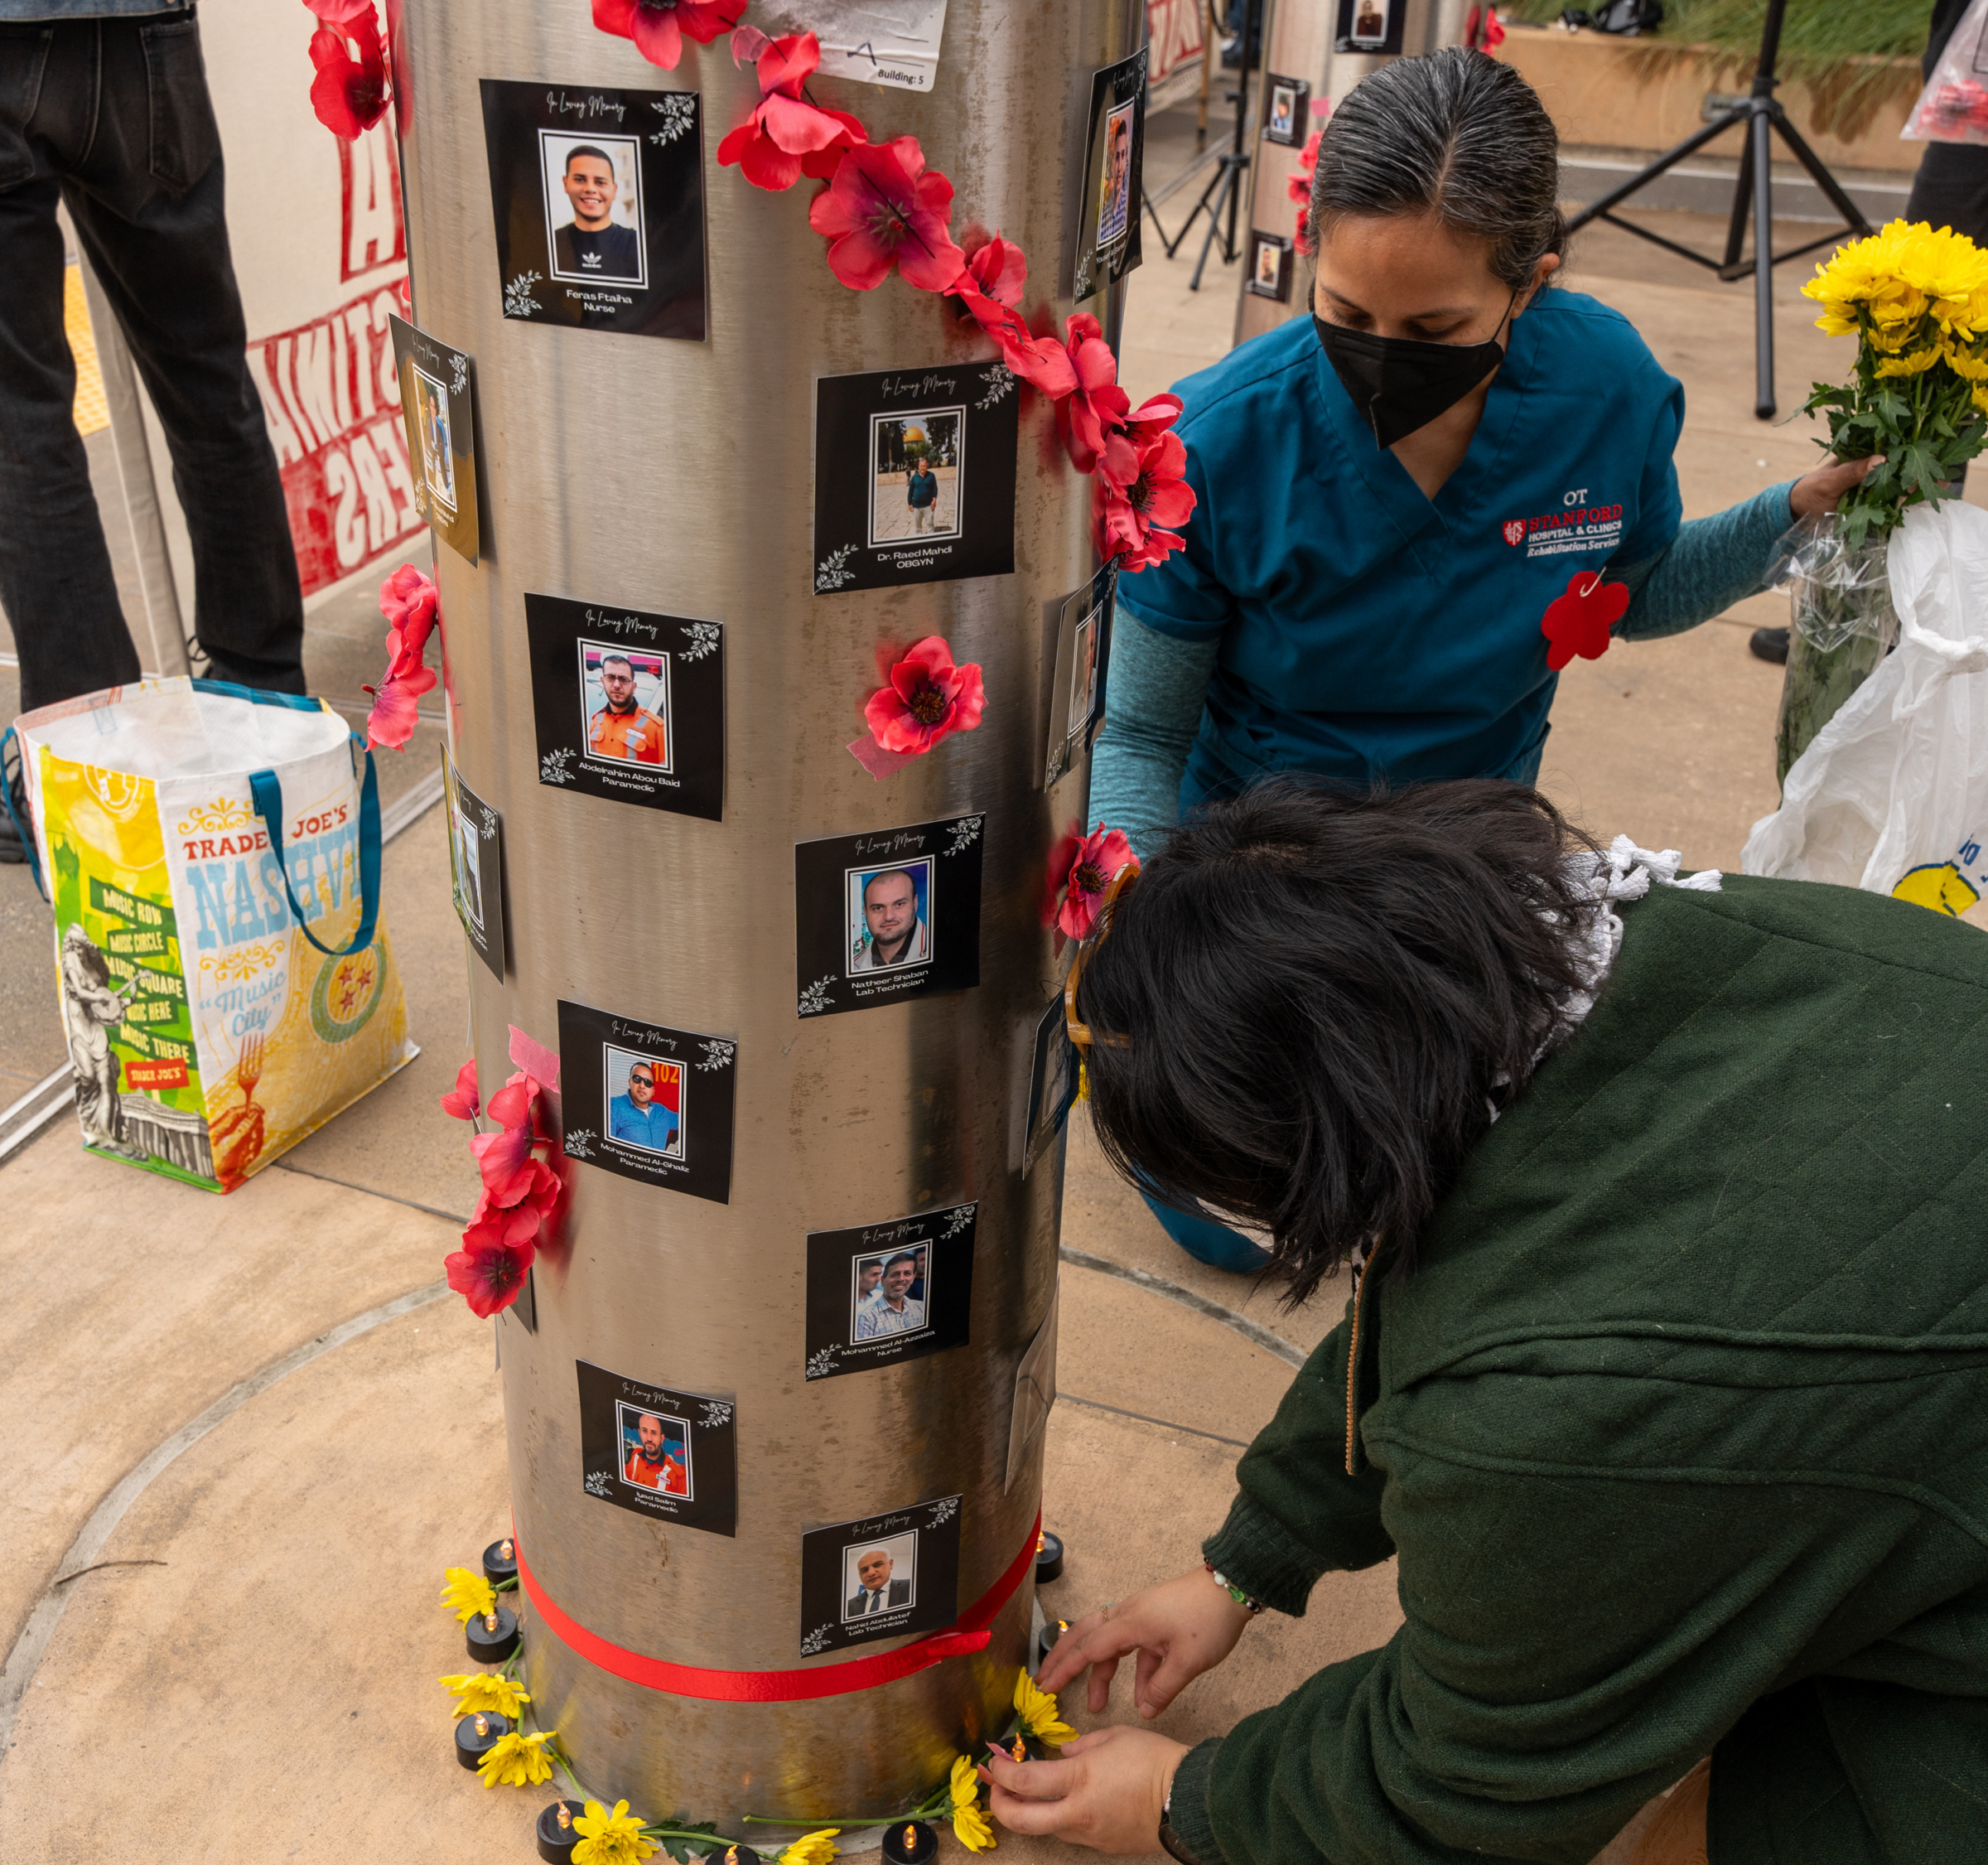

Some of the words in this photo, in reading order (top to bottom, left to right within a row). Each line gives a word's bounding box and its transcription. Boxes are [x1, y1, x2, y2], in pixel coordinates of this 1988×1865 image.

[878, 69, 916, 84] Building:
[918, 75, 924, 84] 5
[547, 91, 557, 114] In
[559, 92, 586, 118] Loving
[587, 94, 627, 122] Memory
[566, 289, 596, 301] Feras
[597, 292, 633, 304] Ftaiha
[583, 302, 615, 313] Nurse
[882, 378, 892, 399] In
[894, 377, 921, 398] Loving
[923, 374, 957, 395] Memory
[1563, 488, 1588, 507] OT
[1529, 504, 1623, 532] STANFORD
[1528, 527, 1574, 543] HOSPITAL
[1575, 526, 1585, 535] &
[1586, 519, 1623, 534] CLINICS
[877, 553, 892, 562] Dr.
[893, 549, 921, 560] Raed
[922, 545, 953, 557] Mahdi
[1527, 541, 1587, 558] Rehabilitation
[896, 558, 934, 569] OBGYN
[586, 609, 596, 627] In
[597, 611, 623, 634] Loving
[624, 616, 659, 640] Memory
[578, 762, 630, 779] Abdelrahim
[631, 773, 658, 784] Abou
[658, 777, 681, 788] Baid
[602, 776, 656, 793] Paramedic
[182, 830, 278, 861] TRADE
[292, 803, 348, 839] JOE'S
[855, 838, 866, 856] In
[866, 838, 893, 854] Loving
[894, 832, 927, 851] Memory
[186, 817, 362, 950] NASHVI
[103, 887, 135, 919] MUSIC
[137, 901, 163, 926] ROW
[109, 934, 133, 953] MUSIC
[133, 930, 165, 953] CIRCLE
[852, 978, 893, 989] Natheer
[893, 969, 929, 983] Shaban
[856, 988, 875, 997] Lab
[876, 978, 925, 993] Technician
[119, 1022, 150, 1052] MUSIC
[152, 1036, 191, 1064] THERE
[611, 1020, 621, 1035] In
[622, 1022, 645, 1044] Loving
[646, 1030, 678, 1051] Memory
[157, 1065, 181, 1080] JOE'S
[653, 1061, 679, 1085] 102
[600, 1143, 651, 1163] Mohammed
[620, 1157, 668, 1175] Paramedic
[862, 1230, 871, 1245] In
[872, 1229, 896, 1242] Loving
[896, 1222, 926, 1239] Memory
[841, 1341, 893, 1356] Mohammed
[894, 1330, 936, 1346] Al-Azzaiza
[876, 1346, 903, 1357] Nurse
[621, 1381, 631, 1394] In
[631, 1384, 652, 1403] Loving
[653, 1391, 682, 1411] Memory
[634, 1496, 679, 1514] Paramedic
[636, 1491, 654, 1501] Iyad
[654, 1496, 677, 1507] Salim
[852, 1524, 861, 1537] In
[861, 1522, 883, 1534] Loving
[884, 1515, 911, 1529] Memory
[845, 1621, 869, 1631] Nahid
[865, 1619, 908, 1632] Technician
